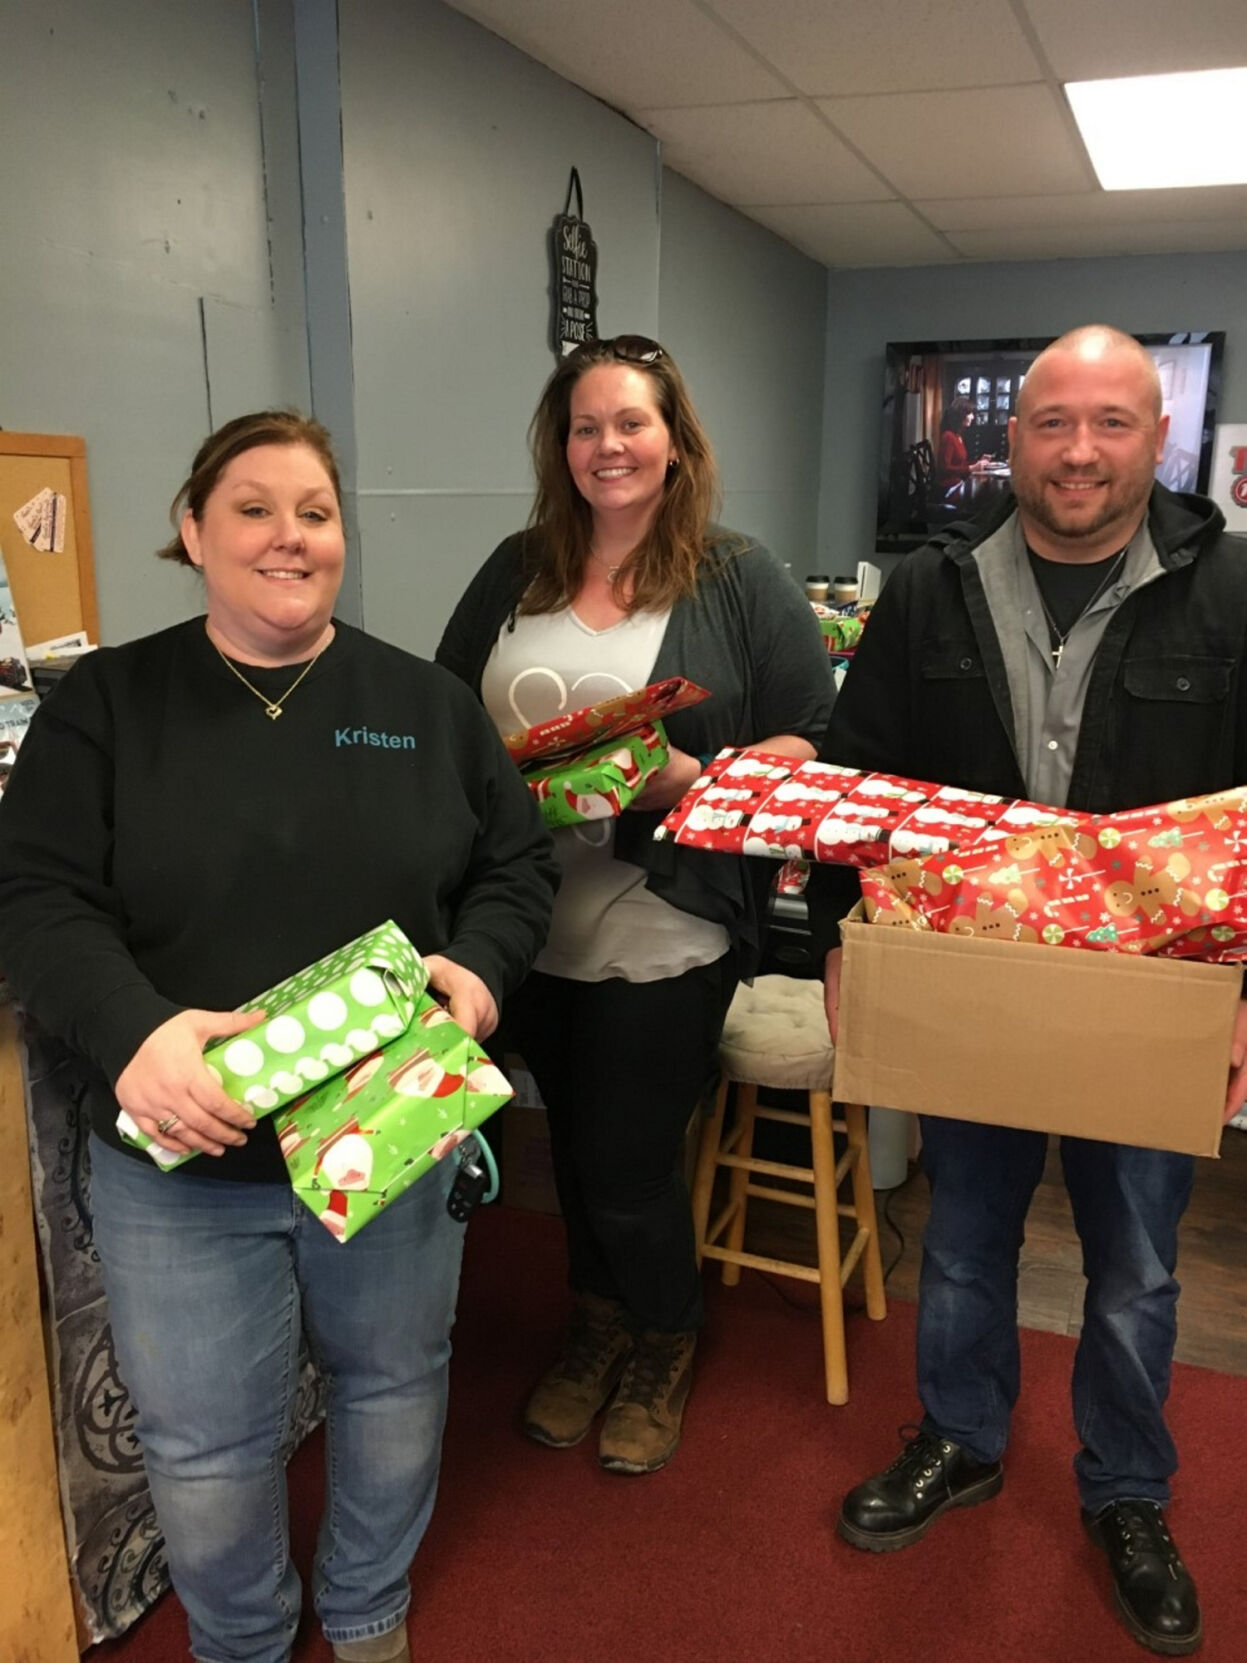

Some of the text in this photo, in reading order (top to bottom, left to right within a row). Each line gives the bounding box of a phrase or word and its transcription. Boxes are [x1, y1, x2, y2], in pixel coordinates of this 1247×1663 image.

[563, 225, 587, 260] Selfie
[562, 255, 591, 282] STATION
[334, 725, 416, 749] Kristen
